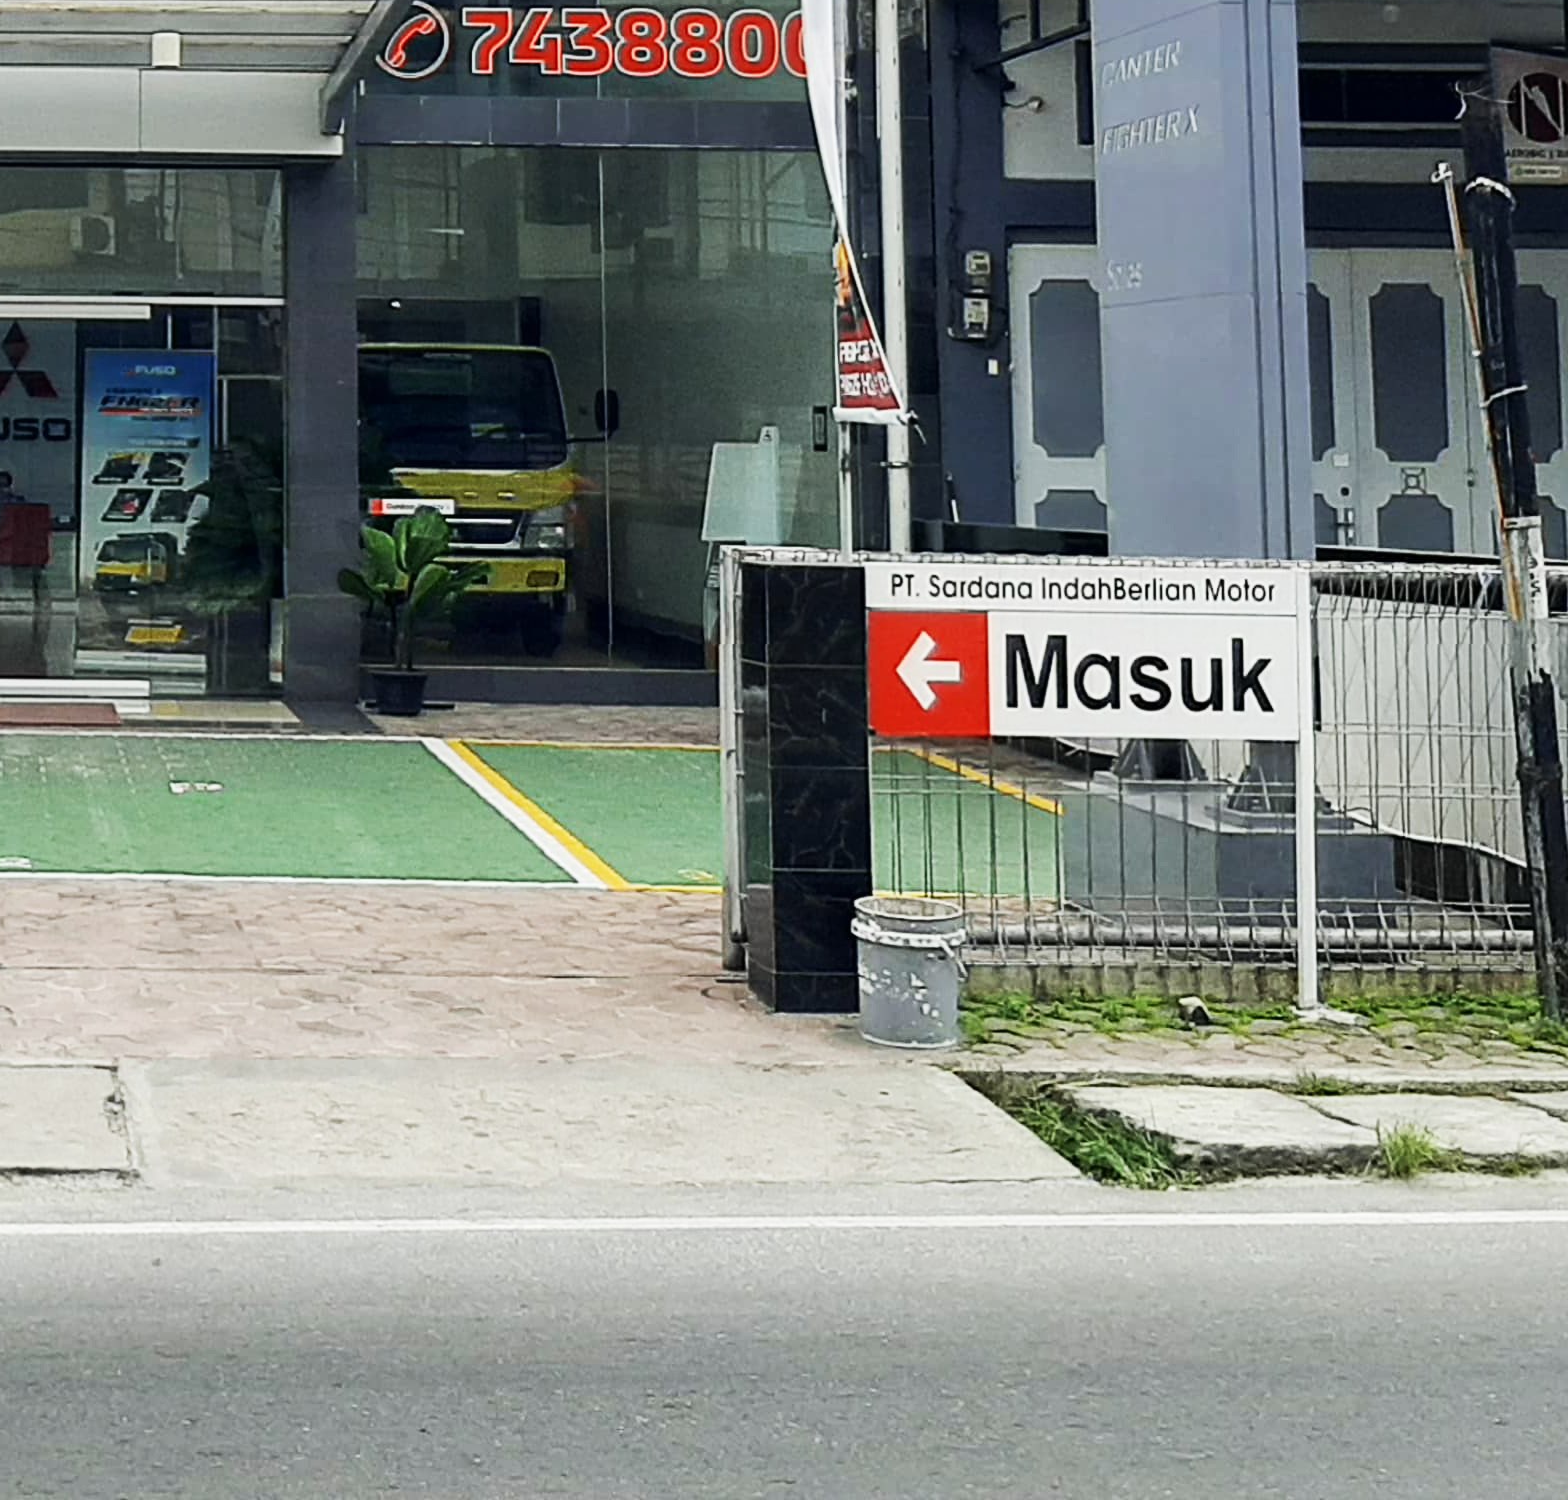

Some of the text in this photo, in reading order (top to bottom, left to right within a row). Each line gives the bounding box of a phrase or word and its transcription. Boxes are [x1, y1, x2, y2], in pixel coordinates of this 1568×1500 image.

[1101, 110, 1181, 156] FIGHTER
[891, 573, 920, 598] PT.
[928, 574, 1033, 600] Sardana
[1204, 578, 1276, 603] Motor
[1004, 634, 1274, 713] Masuk
